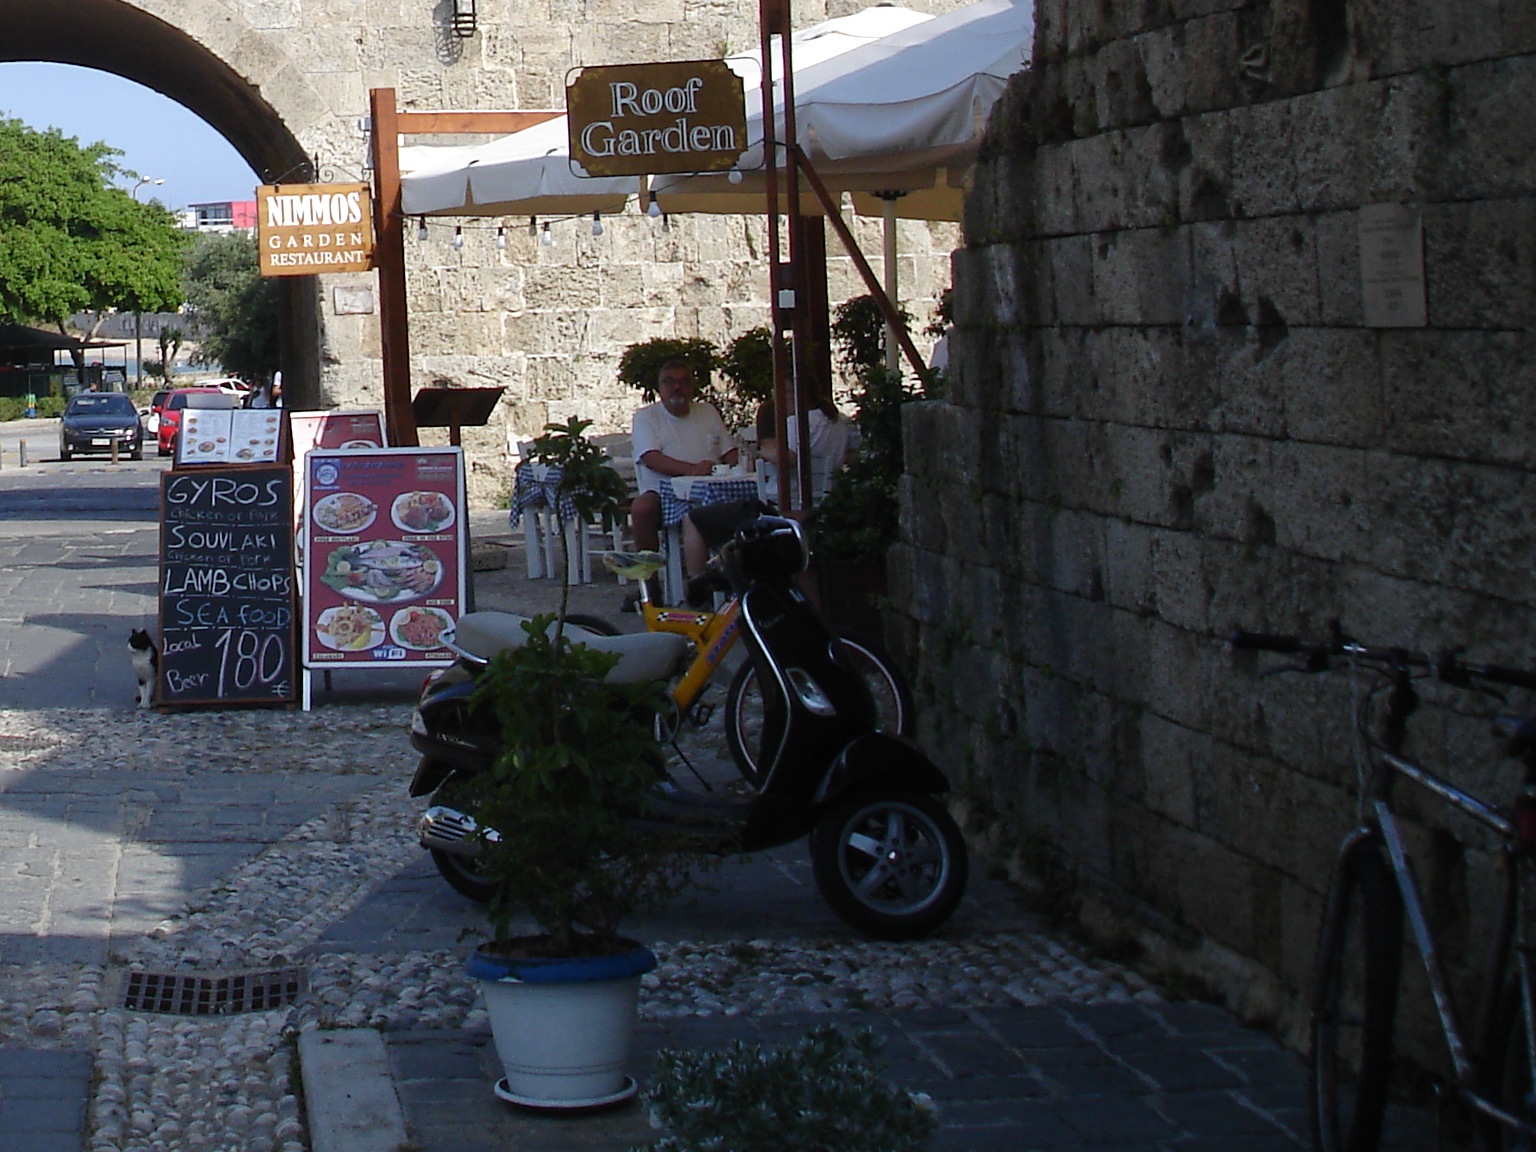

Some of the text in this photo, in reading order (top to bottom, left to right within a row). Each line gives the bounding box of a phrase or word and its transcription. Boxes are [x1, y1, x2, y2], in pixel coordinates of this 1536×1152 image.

[610, 77, 703, 118] Roof
[580, 118, 736, 158] Garden
[267, 192, 362, 227] NIMMOS
[269, 233, 363, 249] GARDEN
[270, 250, 364, 267] RESTAURANT
[167, 476, 283, 507] GYROS
[228, 511, 242, 521] or
[167, 524, 276, 552] SOUVLAKI
[164, 568, 291, 595] LAMB CHOPS
[176, 598, 230, 626] SEA
[166, 669, 209, 693] Beer
